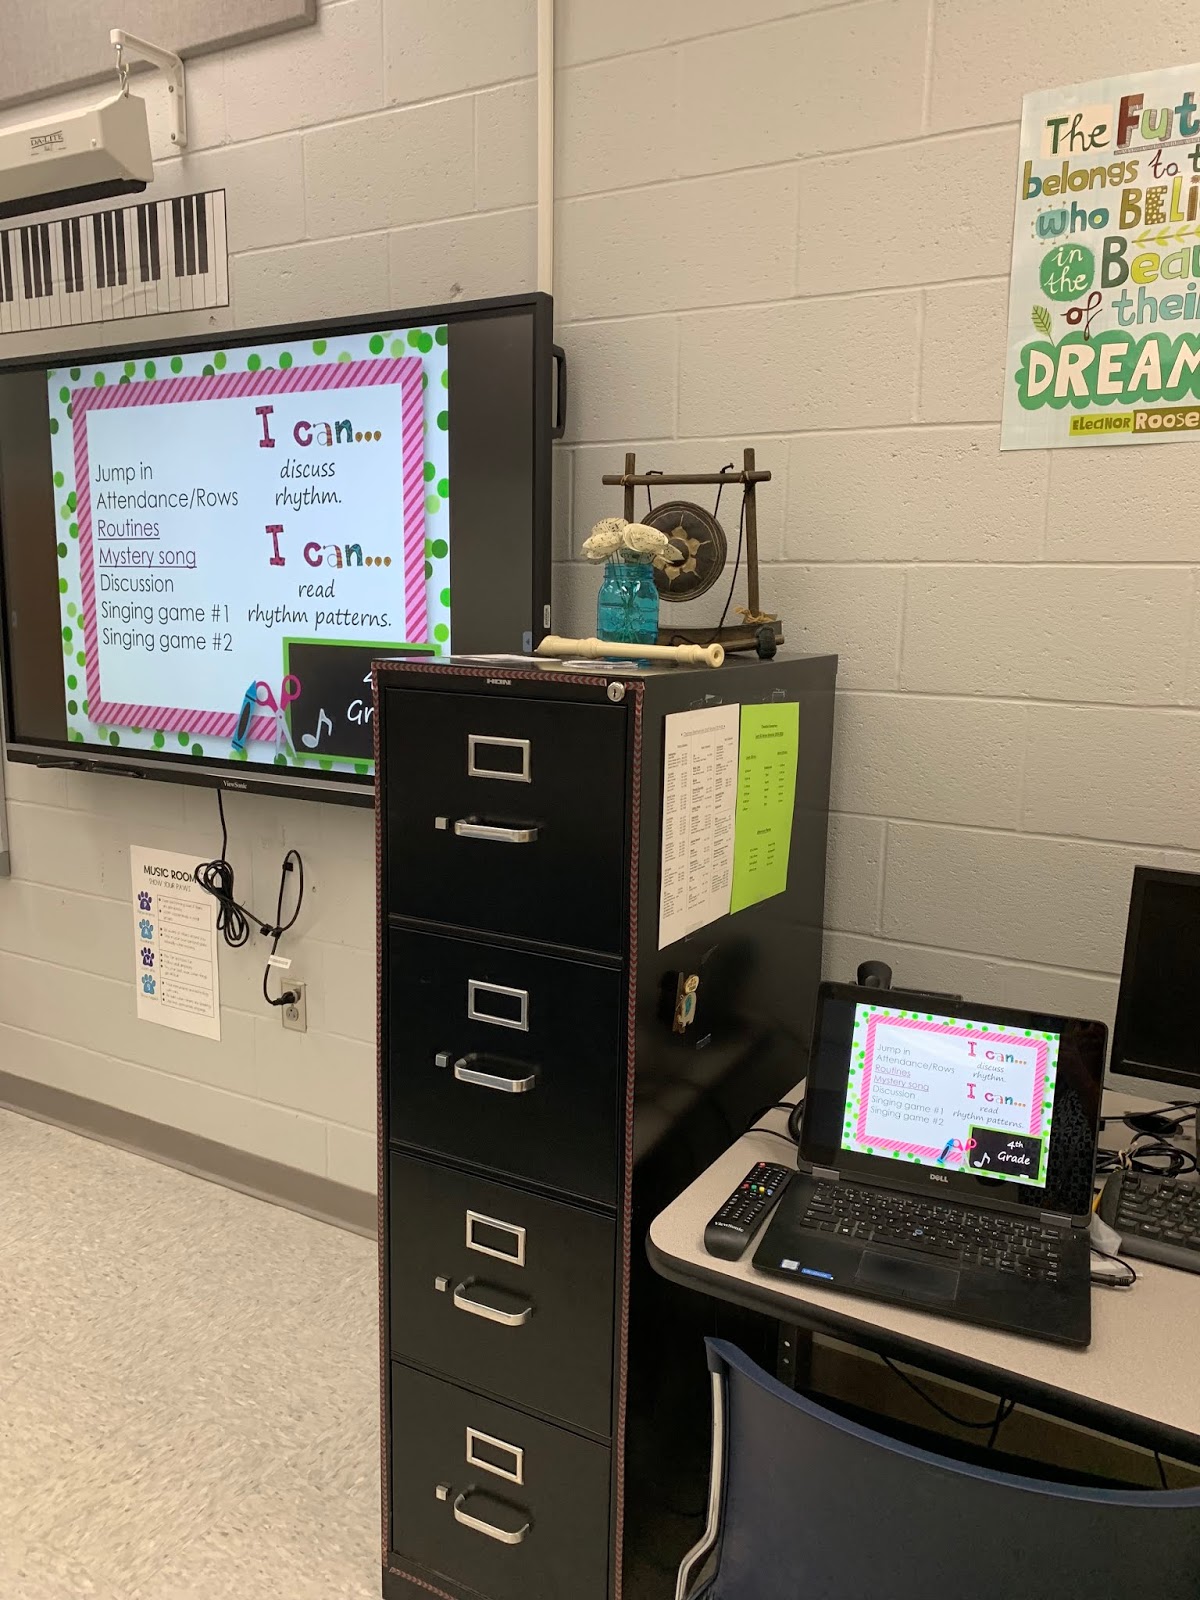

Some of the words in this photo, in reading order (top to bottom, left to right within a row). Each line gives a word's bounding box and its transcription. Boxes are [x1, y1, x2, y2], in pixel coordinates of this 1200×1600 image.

[1047, 113, 1110, 154] The
[1022, 160, 1140, 200] belongs
[1148, 149, 1180, 179] to
[1038, 201, 1109, 236] who
[1052, 247, 1083, 267] in
[1044, 266, 1088, 294] the
[1060, 291, 1103, 341] of
[1112, 283, 1200, 326] thei
[1028, 340, 1200, 398] DREAM
[255, 405, 276, 448] I
[95, 464, 136, 485] Jump
[139, 463, 154, 481] in
[280, 459, 336, 480] discuss
[96, 488, 239, 510] Attendance/Rows
[275, 488, 342, 511] rhythm.
[97, 519, 161, 540] Routines
[265, 524, 286, 567] I
[98, 548, 155, 568] Mystery
[158, 550, 197, 569] song
[100, 574, 174, 594] Discussion
[298, 580, 336, 598] read
[101, 601, 154, 623] Singing
[158, 606, 205, 623] game
[210, 604, 230, 622] #1
[247, 605, 309, 628] rhythm
[315, 609, 392, 630] patterns.
[102, 628, 156, 651] Singing
[159, 634, 207, 652] game
[212, 633, 233, 652] #2
[143, 865, 169, 878] MUSIC
[171, 870, 197, 884] ROOM
[877, 1044, 901, 1054] Jump
[903, 1047, 911, 1055] in
[968, 1041, 977, 1057] I
[874, 1064, 911, 1078] Routines
[876, 1054, 955, 1074] Attendance/Rows
[977, 1062, 1004, 1073] discuss
[873, 1075, 907, 1088] Mystery
[908, 1081, 930, 1092] song
[873, 1085, 916, 1099] Discussion
[967, 1083, 976, 1099] I
[871, 1096, 902, 1109] Singing
[904, 1102, 931, 1113] game
[933, 1107, 944, 1115] #1
[980, 1106, 999, 1114] read
[870, 1106, 901, 1120] Singing
[903, 1113, 930, 1123] game
[932, 1118, 944, 1126] #2
[953, 1110, 984, 1121] rhythm
[986, 1116, 1024, 1129] patterns.
[1007, 1141, 1024, 1150] 4th
[997, 1151, 1031, 1165] Grade
[929, 1173, 949, 1183] DELL
